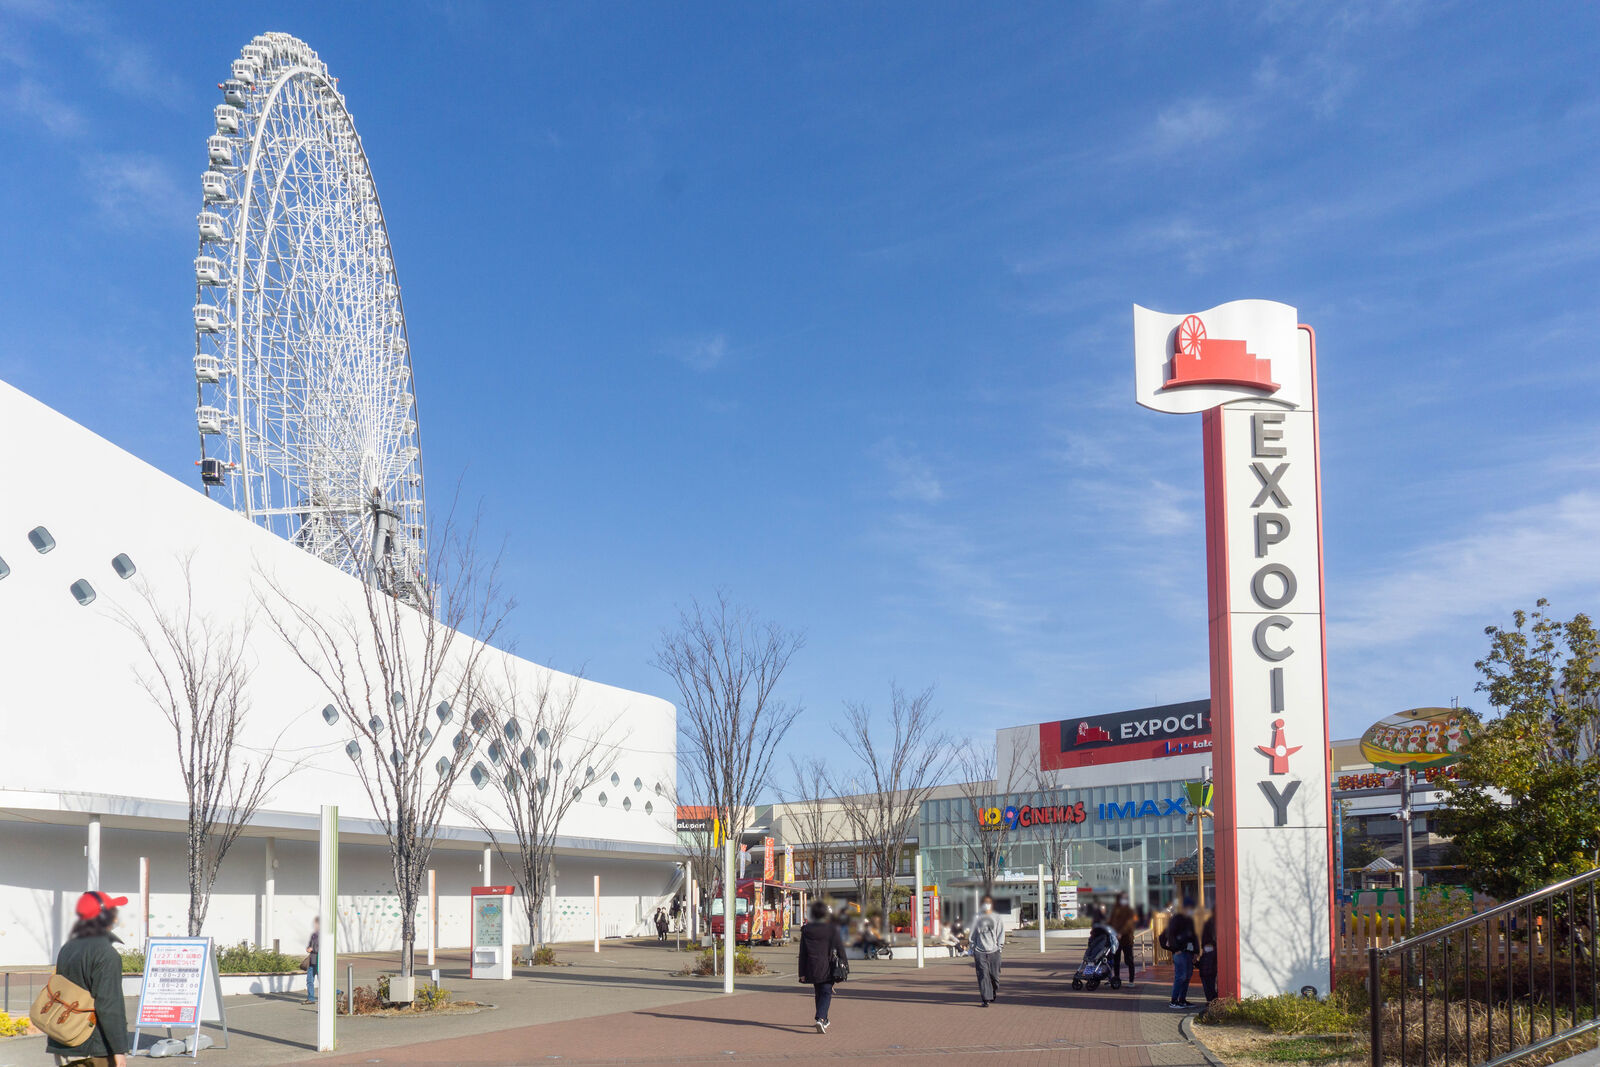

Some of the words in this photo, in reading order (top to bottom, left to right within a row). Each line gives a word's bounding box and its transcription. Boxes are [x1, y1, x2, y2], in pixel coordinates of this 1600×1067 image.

[1120, 712, 1212, 739] EXPOCI
[1193, 739, 1212, 749] LaLa
[1099, 797, 1188, 820] IMAX
